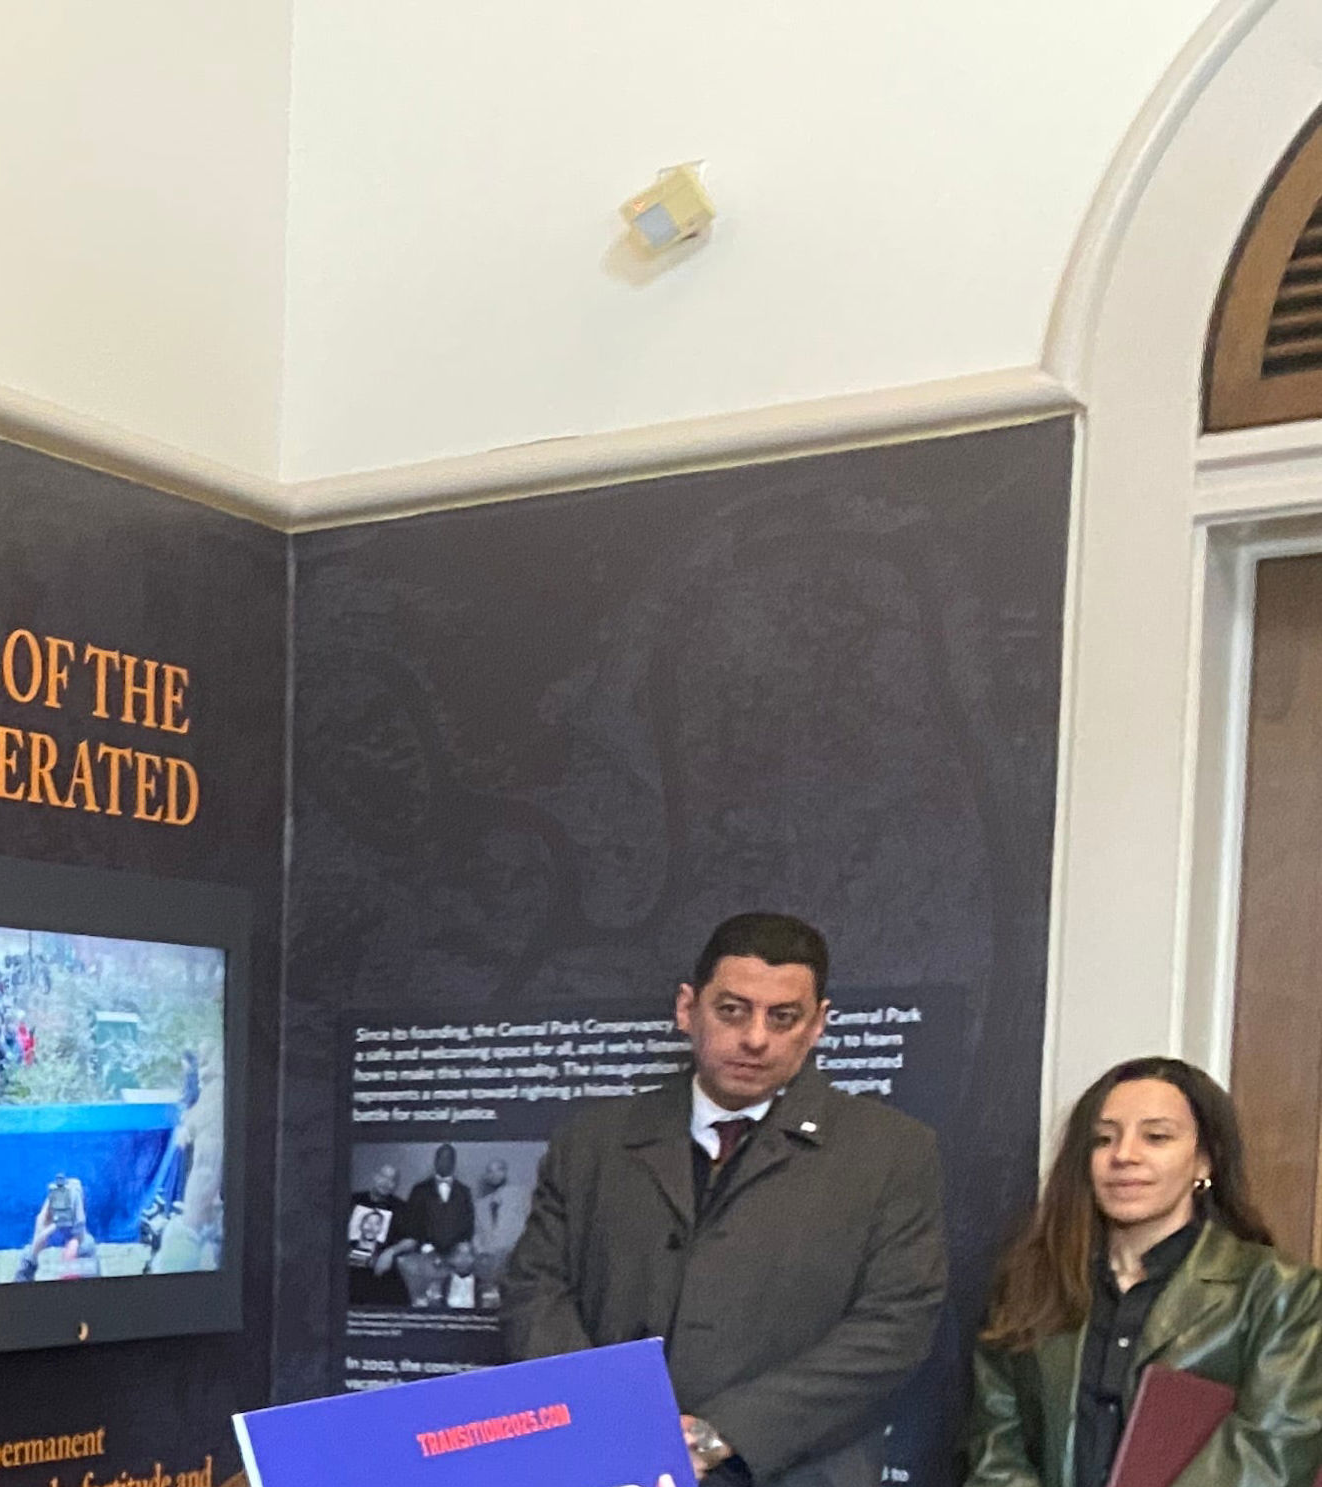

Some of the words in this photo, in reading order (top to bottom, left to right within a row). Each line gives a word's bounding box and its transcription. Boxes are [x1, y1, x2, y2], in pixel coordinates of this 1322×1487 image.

[2, 629, 76, 709] OF
[84, 643, 190, 734] THE
[355, 1028, 390, 1042] Since
[410, 1025, 471, 1041] founding,
[473, 1024, 495, 1037] the
[497, 1022, 547, 1037] Central
[550, 1020, 581, 1036] Park
[583, 1018, 675, 1035] Conservancy
[826, 1009, 883, 1026] Central
[885, 1007, 922, 1023] Park
[365, 1047, 392, 1061] safe
[394, 1047, 419, 1061] and
[421, 1045, 490, 1062] welcoming
[492, 1046, 531, 1060] space
[533, 1041, 554, 1056] for
[577, 1040, 605, 1055] and
[843, 1035, 861, 1047] to
[863, 1031, 903, 1046] learn
[354, 1069, 381, 1082] how
[400, 1067, 434, 1081] make
[437, 1067, 462, 1080] this
[464, 1066, 502, 1079] vision
[563, 1061, 591, 1077] The
[592, 1061, 679, 1078] inauguration
[815, 1053, 903, 1071] Exonerated
[354, 1091, 419, 1104] represents
[433, 1089, 468, 1101] move
[470, 1085, 518, 1099] toward
[520, 1084, 571, 1101] righting
[584, 1083, 636, 1097] historic
[353, 1108, 390, 1122] battle
[392, 1107, 411, 1121] for
[413, 1107, 449, 1121] social
[345, 1356, 359, 1370] In
[399, 1359, 422, 1373] the
[416, 1403, 572, 1457] TRANSITION2025.COM
